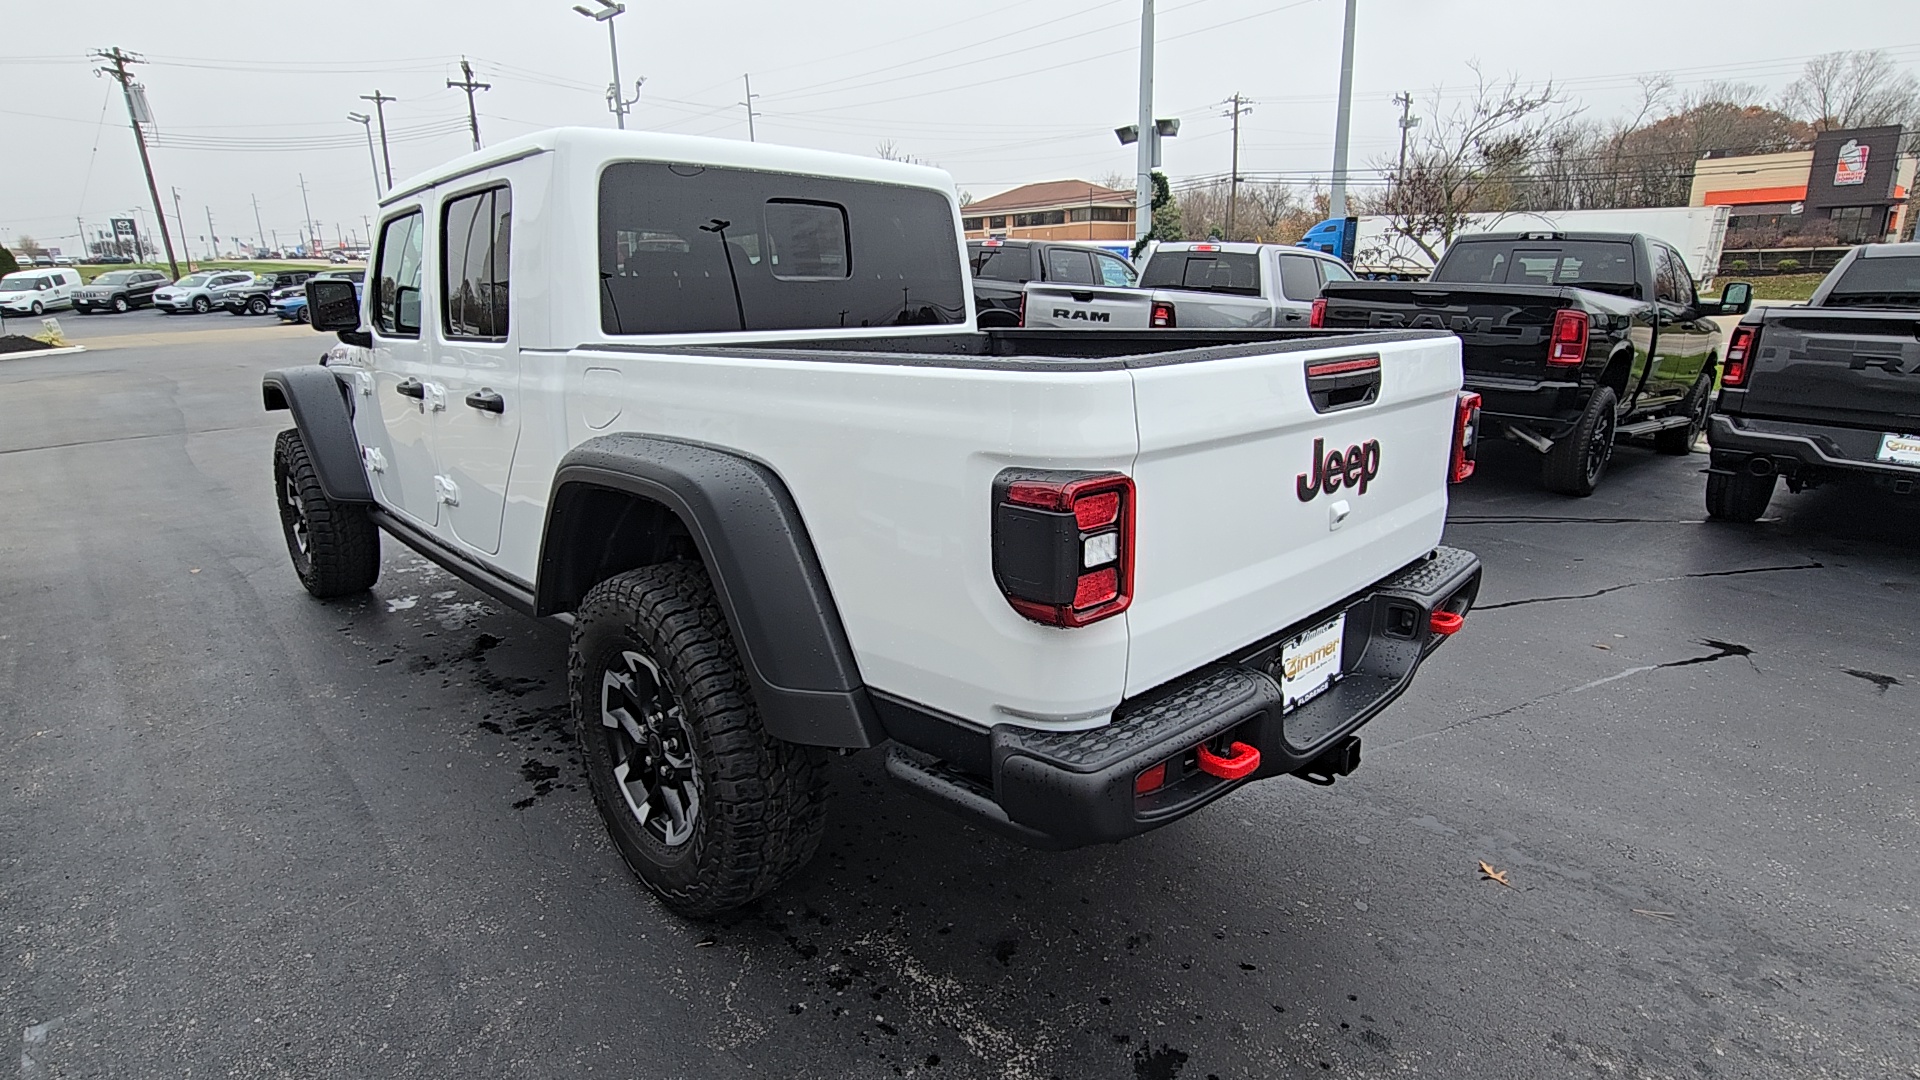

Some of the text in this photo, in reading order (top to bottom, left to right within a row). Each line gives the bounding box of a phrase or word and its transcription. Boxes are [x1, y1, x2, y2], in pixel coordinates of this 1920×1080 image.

[1053, 308, 1110, 323] RAM
[1368, 311, 1494, 332] RAM
[1296, 437, 1381, 503] Jeep
[1285, 638, 1340, 679] Zimmer
[1297, 681, 1329, 707] FLORENCE
